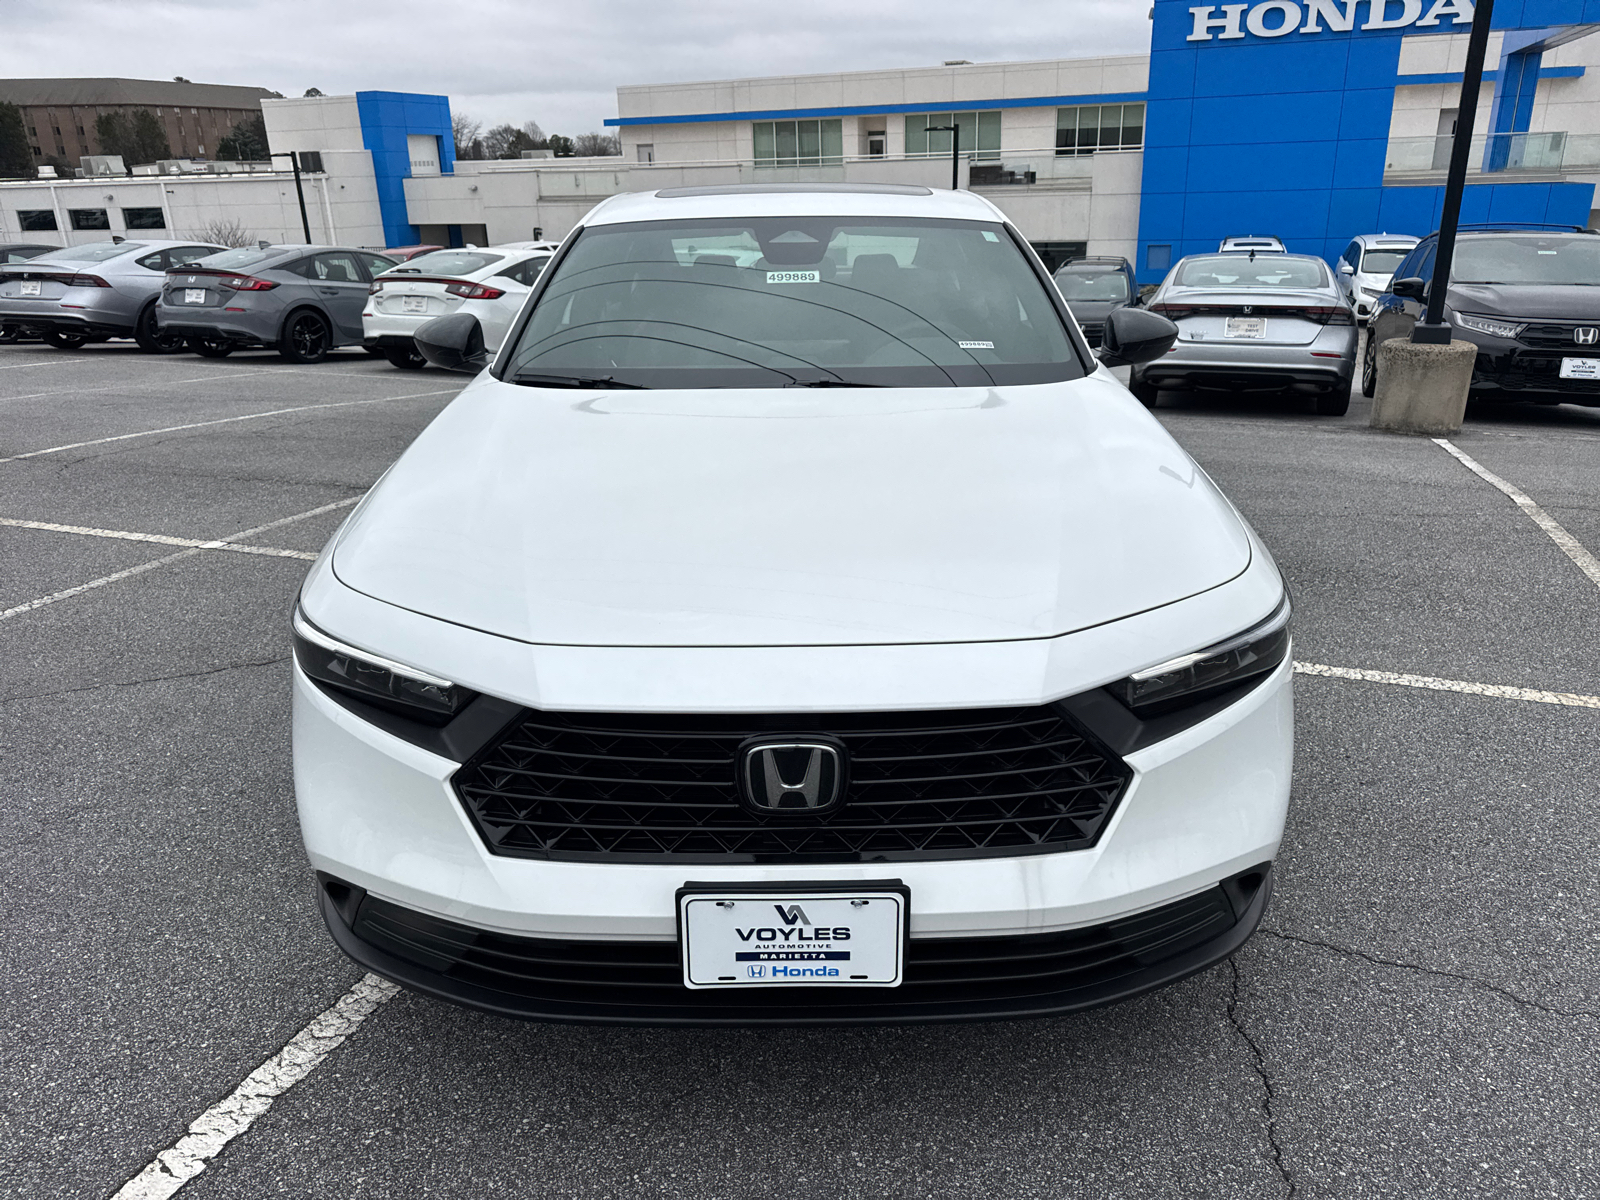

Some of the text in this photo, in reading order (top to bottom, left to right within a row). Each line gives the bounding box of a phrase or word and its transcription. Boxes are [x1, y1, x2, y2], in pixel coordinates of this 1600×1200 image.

[1186, 0, 1476, 41] HONDA
[768, 272, 816, 282] 499889
[735, 926, 851, 941] VOYLES
[772, 965, 840, 977] Honda
